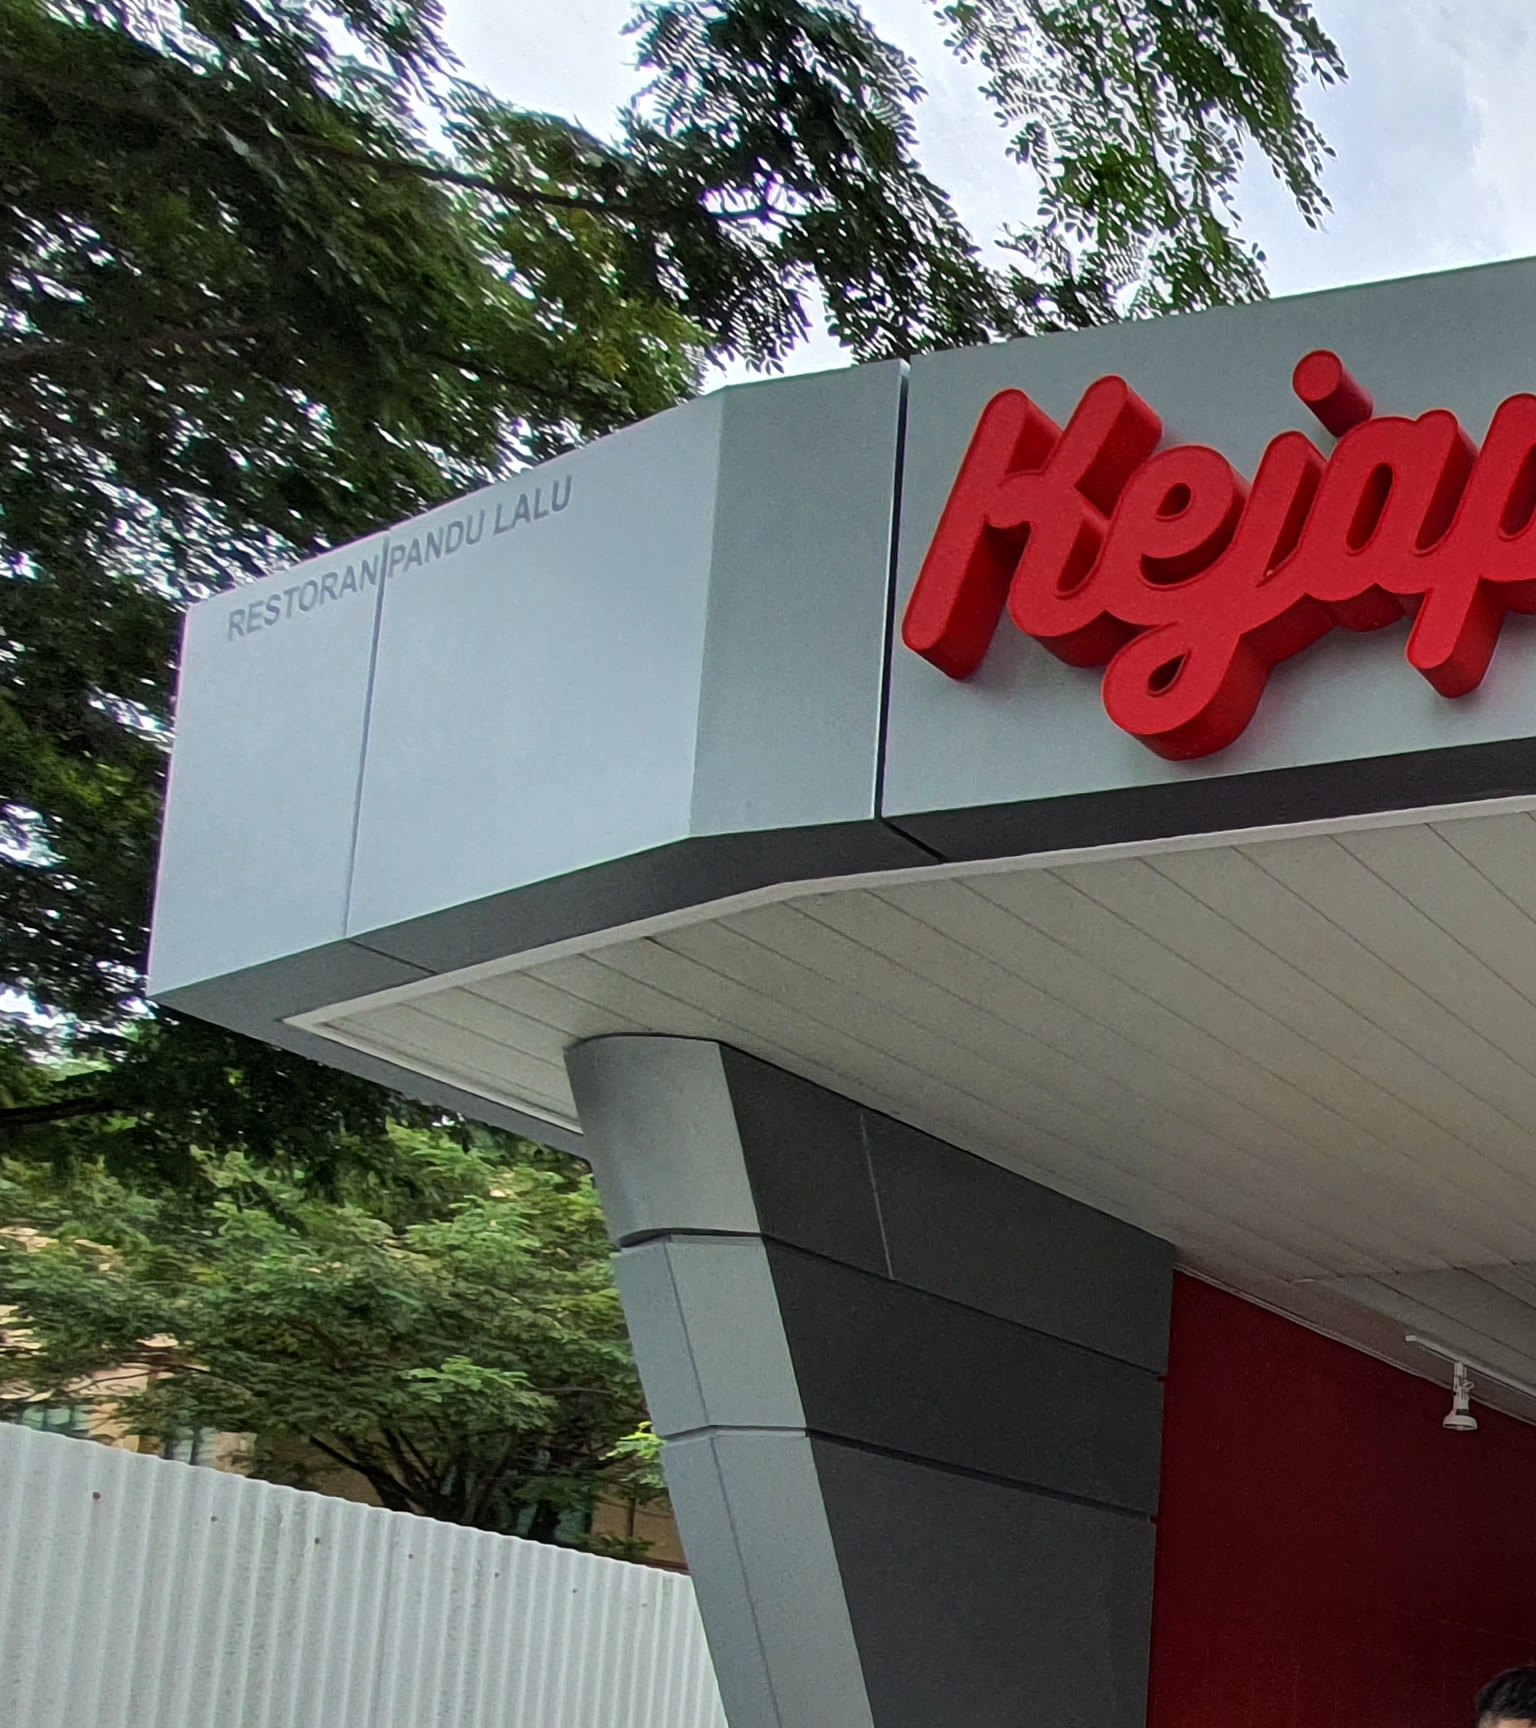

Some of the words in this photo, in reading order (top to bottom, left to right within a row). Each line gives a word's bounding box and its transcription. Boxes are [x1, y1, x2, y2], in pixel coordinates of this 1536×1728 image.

[227, 556, 378, 641] RESTORAN
[387, 509, 485, 579] PANDU
[492, 475, 574, 535] LALU
